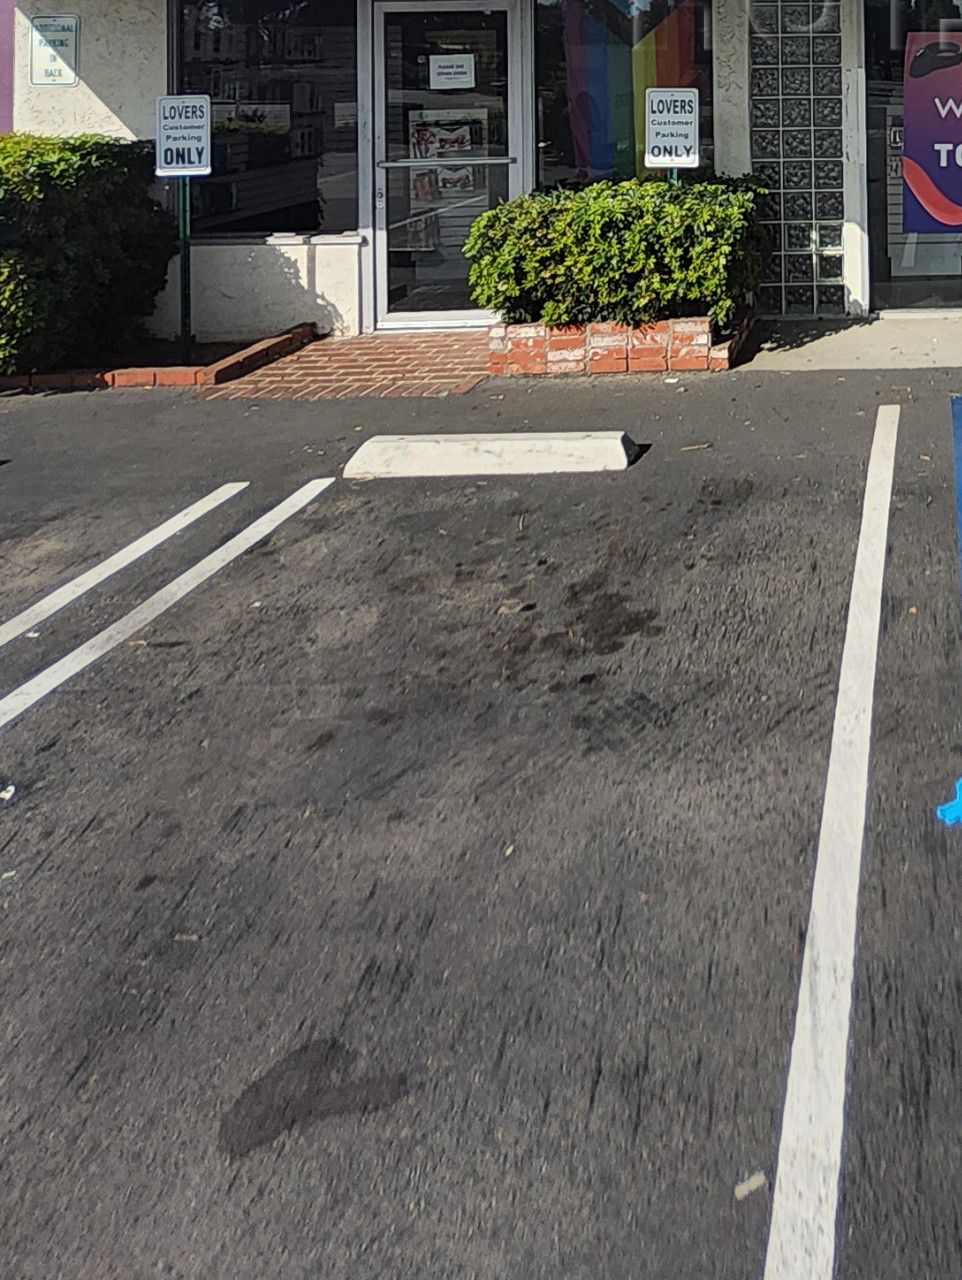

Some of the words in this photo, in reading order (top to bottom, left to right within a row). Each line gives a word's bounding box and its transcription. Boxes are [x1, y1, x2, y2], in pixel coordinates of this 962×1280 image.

[44, 68, 63, 78] BACK
[163, 105, 205, 120] LOVERS
[651, 99, 694, 115] LOVERS
[165, 134, 202, 142] Parking
[655, 131, 689, 139] Parking
[164, 147, 205, 166] ONLY
[651, 145, 693, 158] ONLY
